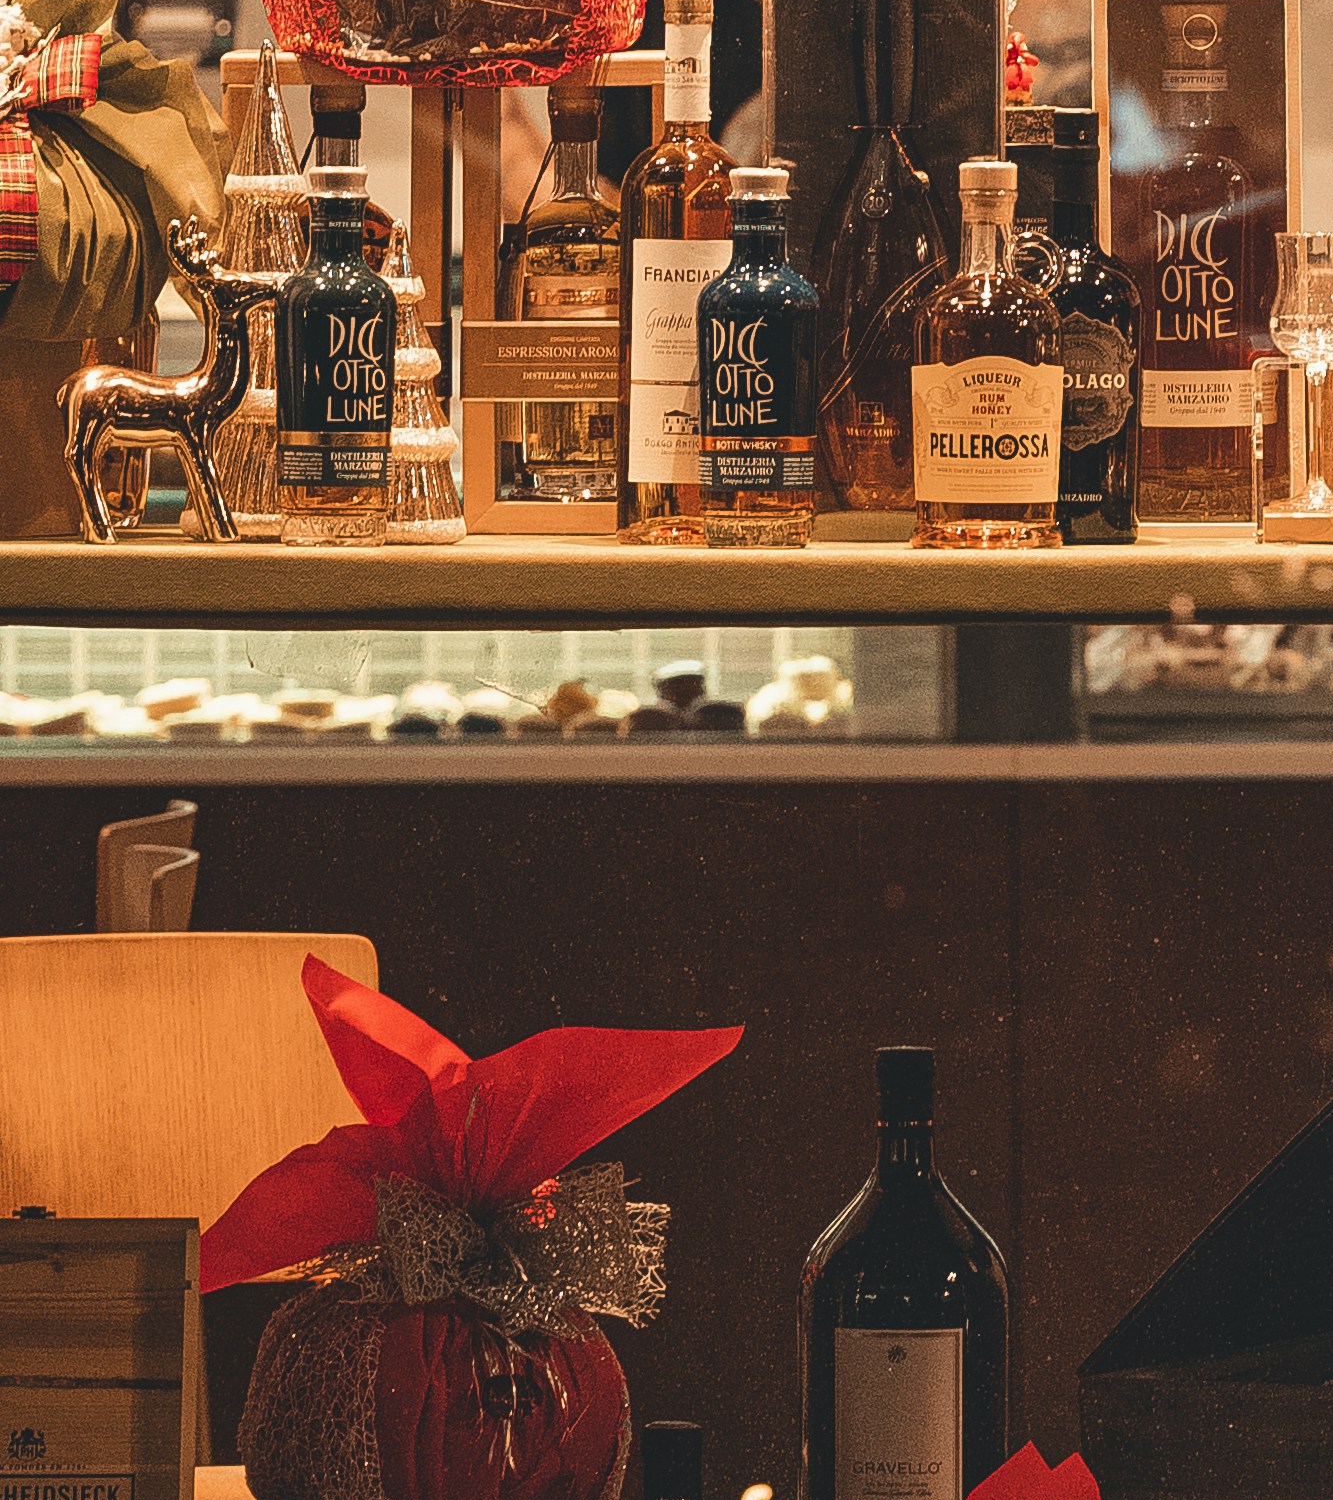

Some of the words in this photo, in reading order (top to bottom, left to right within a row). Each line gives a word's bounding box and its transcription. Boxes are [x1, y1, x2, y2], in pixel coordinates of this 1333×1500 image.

[1161, 264, 1234, 308] OTTO
[645, 306, 693, 340] Grappa
[1155, 307, 1239, 341] LUNE
[497, 346, 576, 359] ESPRESSIONI
[333, 359, 387, 395] OTTO
[522, 371, 577, 380] DISTILLERIA
[716, 363, 774, 399] OTTO
[962, 372, 1022, 388] LIQUEUR
[1163, 383, 1233, 393] DISTILLERIA
[979, 393, 1006, 403] RUM
[1167, 394, 1230, 405] MARZADRO
[326, 394, 388, 423] LUNE
[712, 398, 778, 427] LUNE
[971, 405, 1013, 415] HONEY
[716, 440, 740, 450] BOTTE
[741, 440, 778, 450] WHISKY
[930, 432, 1049, 460] PELLEROSSA
[330, 451, 384, 462] DISTILLERIA
[717, 456, 776, 466] DISTILLERIA
[719, 466, 774, 476] MARZADRO
